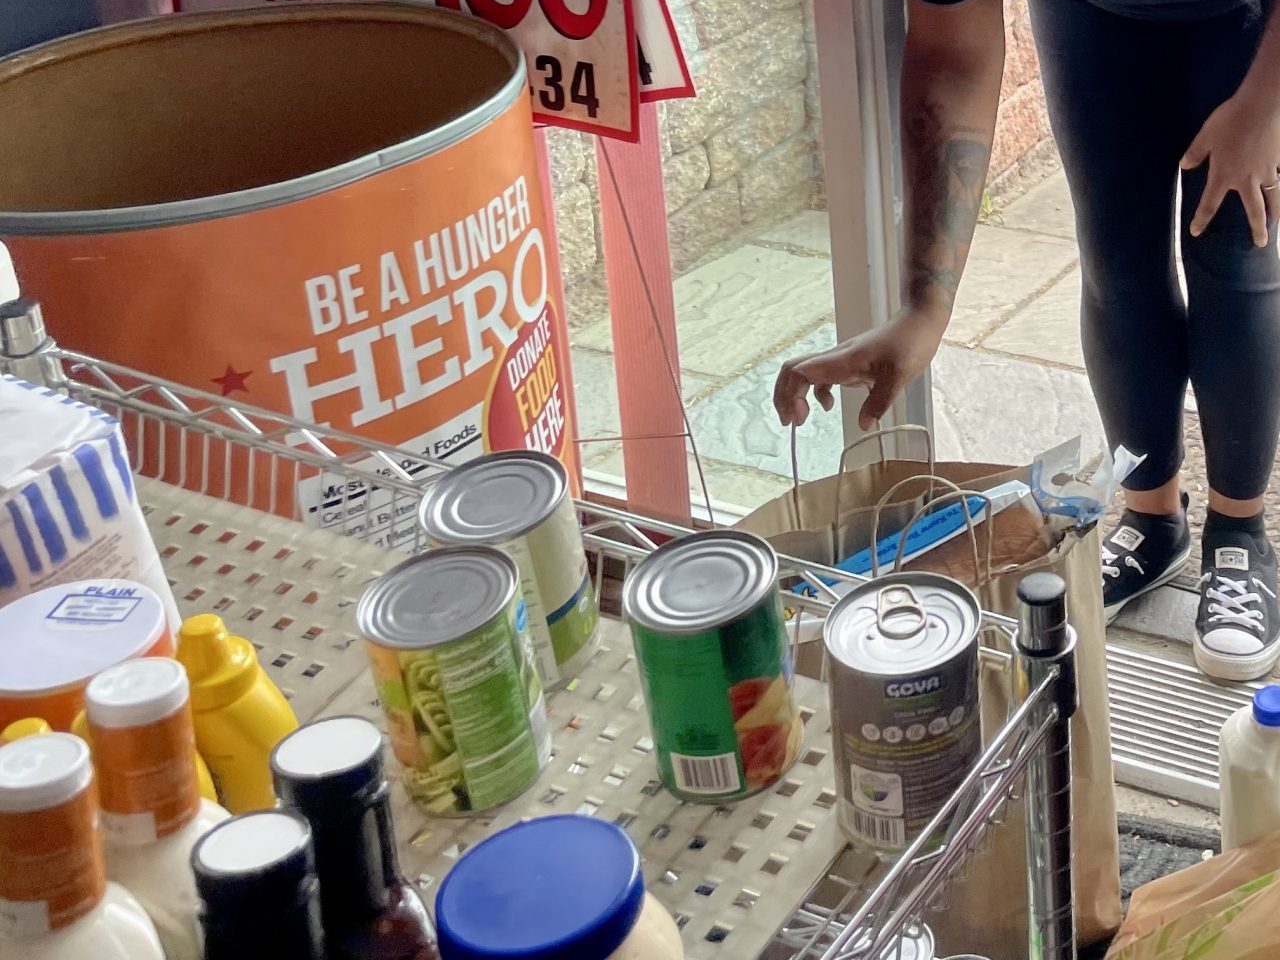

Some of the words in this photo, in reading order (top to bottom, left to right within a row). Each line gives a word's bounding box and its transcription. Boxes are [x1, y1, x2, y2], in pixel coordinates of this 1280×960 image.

[531, 54, 601, 119] 34
[304, 263, 369, 336] BE
[379, 251, 410, 313] A
[413, 175, 532, 296] HUNGER
[269, 227, 548, 449] HERO
[506, 309, 551, 392] DONATE
[515, 343, 557, 433] FOOD
[525, 381, 565, 456] HERE
[434, 422, 478, 456] Foods
[83, 586, 138, 597] PLAIN
[886, 675, 941, 699] GOYA
